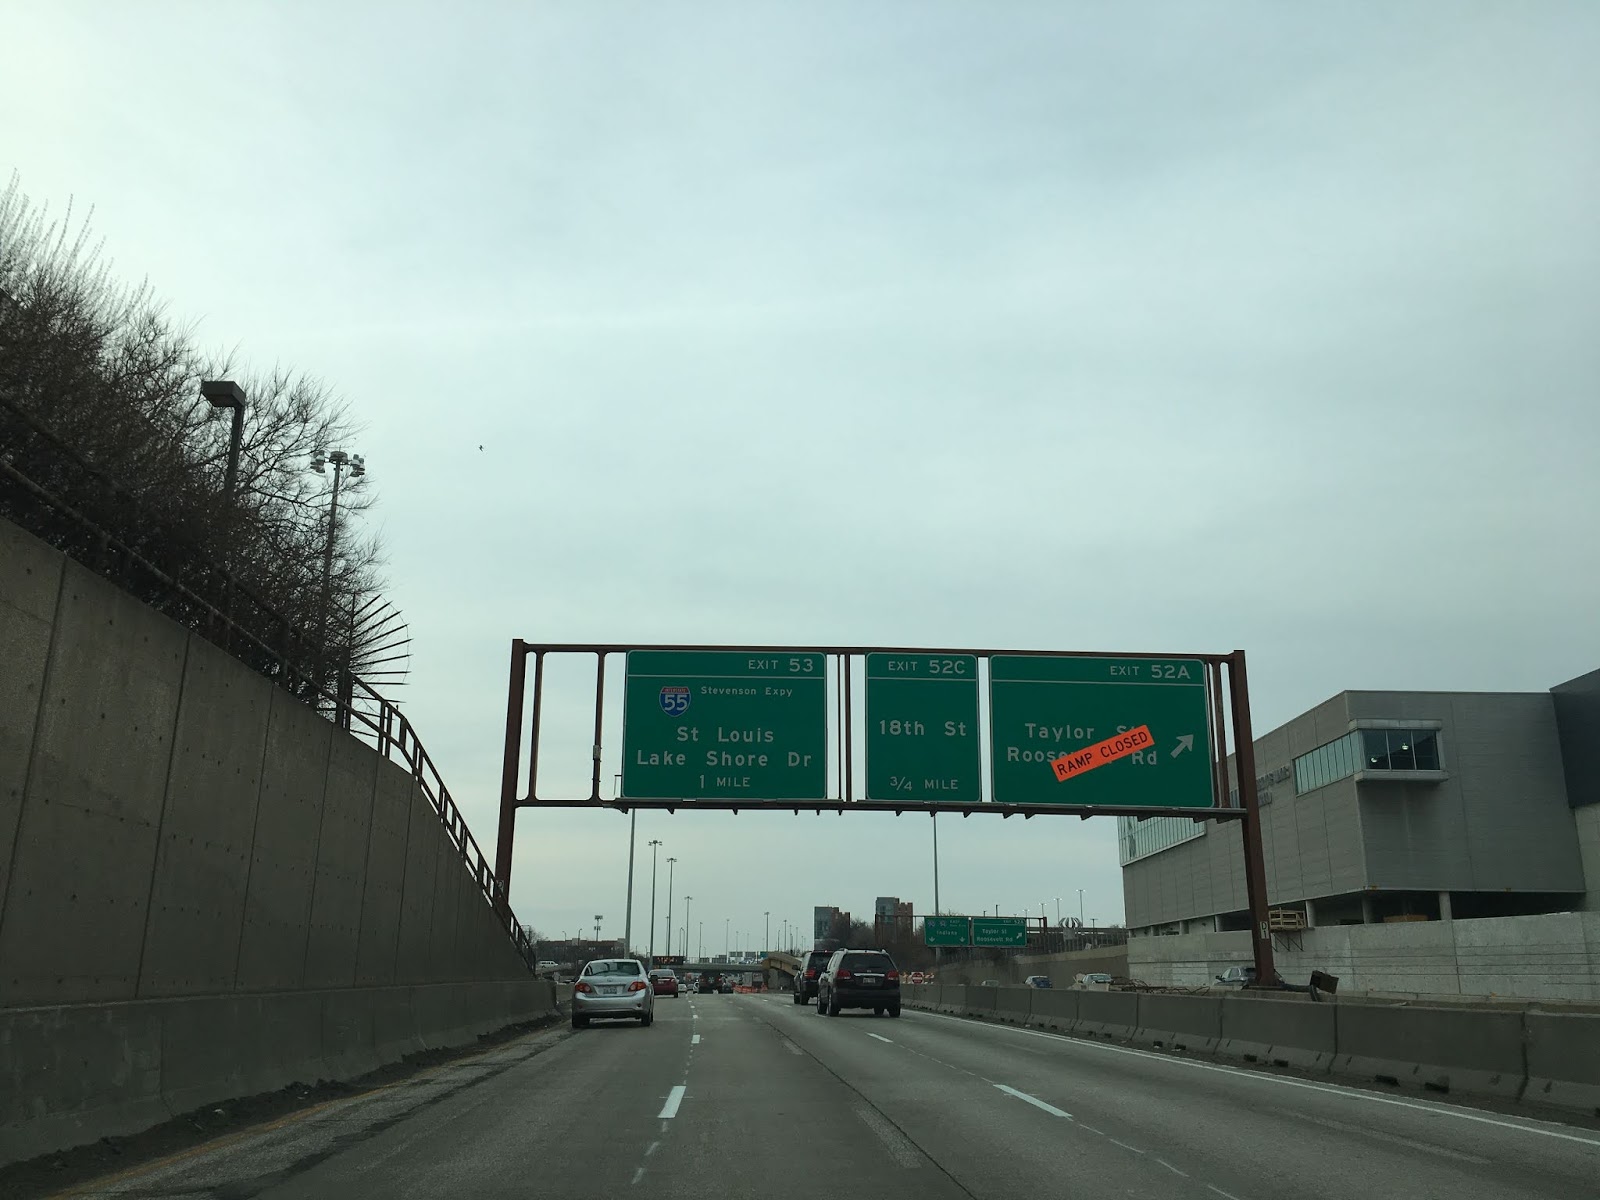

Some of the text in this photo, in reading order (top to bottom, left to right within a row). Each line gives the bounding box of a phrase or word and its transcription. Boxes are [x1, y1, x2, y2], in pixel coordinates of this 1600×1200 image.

[748, 658, 813, 672] EXIT 53
[888, 660, 965, 674] EXIT 52C
[1110, 664, 1191, 679] EXIT 52A
[701, 686, 793, 697] Stevenson Expy
[664, 695, 688, 710] 55
[677, 726, 774, 743] St Louis
[880, 720, 967, 736] 18th St
[1025, 723, 1095, 742] Taylor
[637, 750, 812, 767] Lake Shore Dr
[1056, 731, 1148, 776] RAMP CLOSED
[1131, 750, 1157, 765] Rd
[699, 775, 751, 788] 1 MILE
[889, 776, 958, 791] 3/4 MILE
